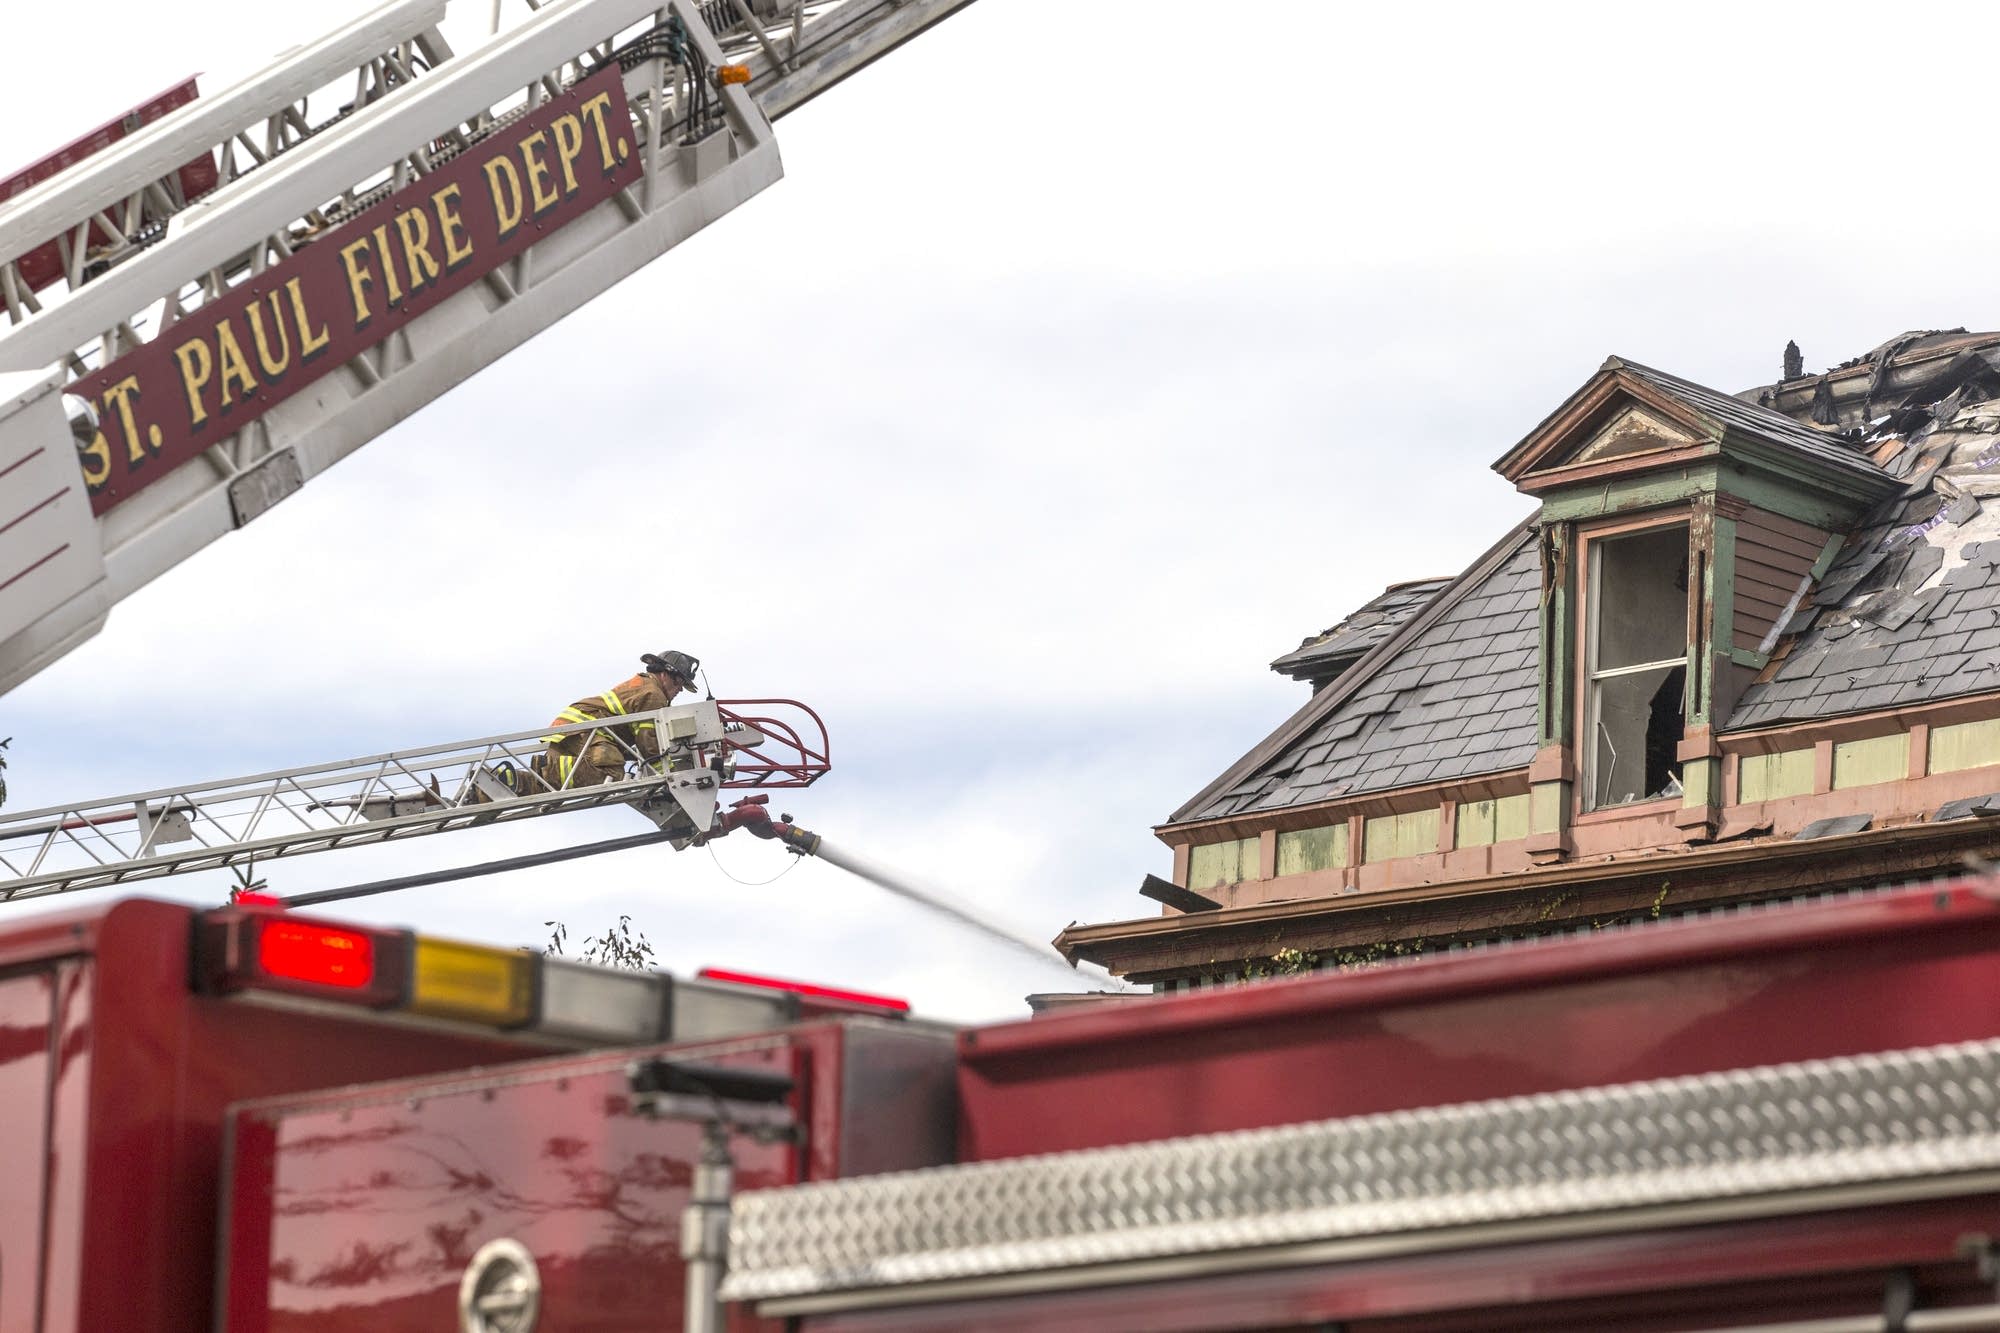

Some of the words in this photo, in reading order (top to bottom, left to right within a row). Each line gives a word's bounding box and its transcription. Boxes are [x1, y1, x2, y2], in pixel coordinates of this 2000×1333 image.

[174, 277, 330, 424] PAUL
[339, 183, 474, 323] FIRE
[484, 92, 629, 233] DEPT.
